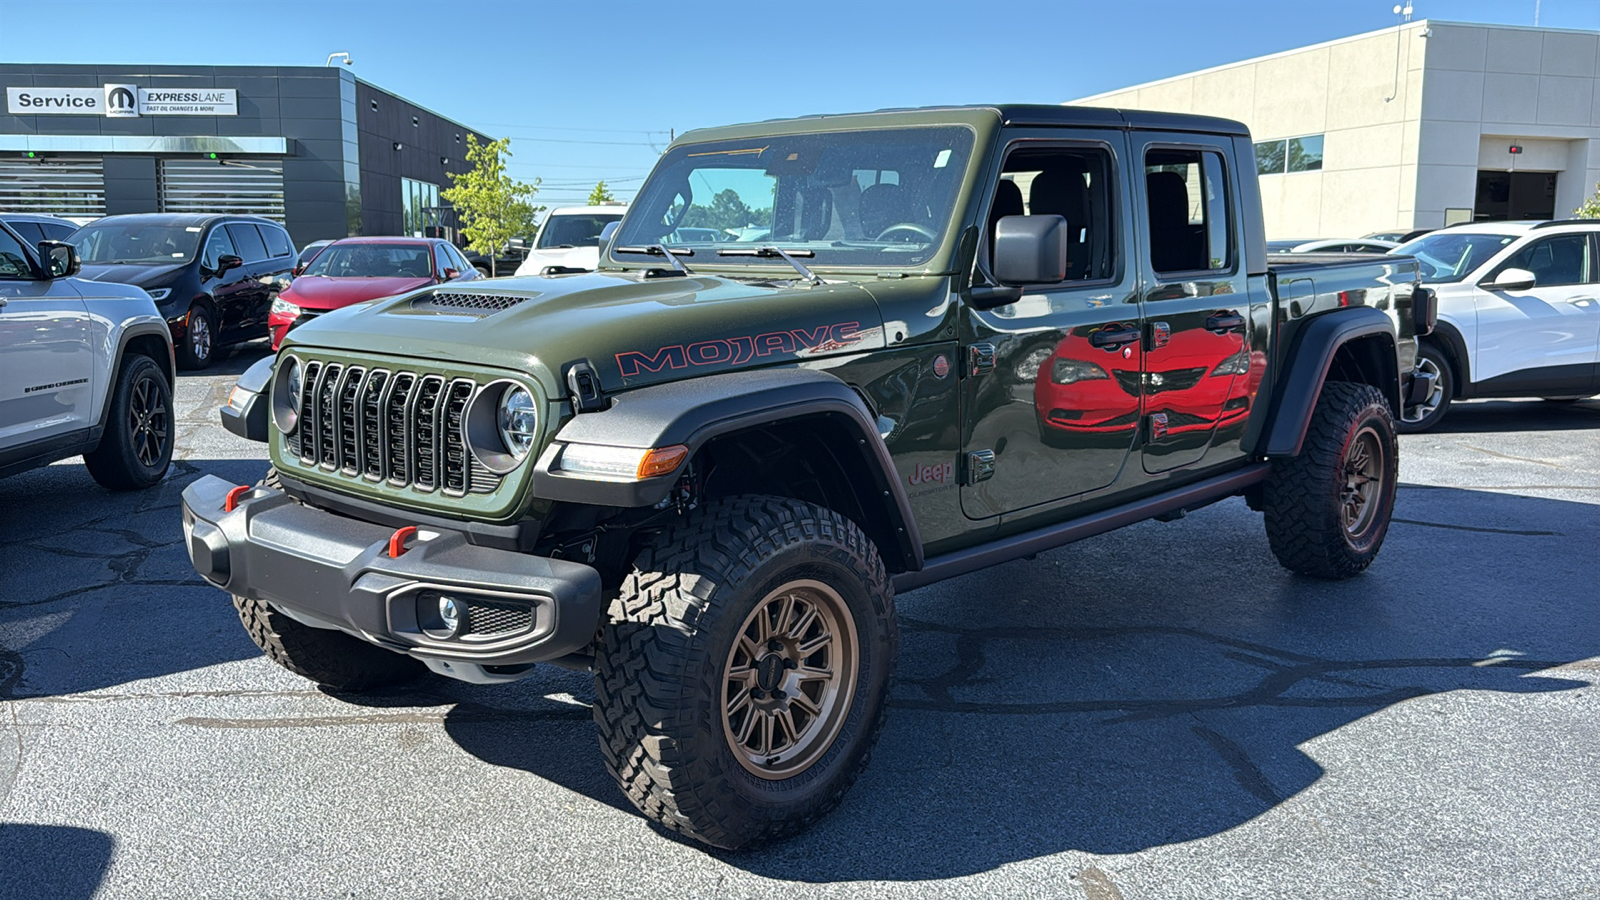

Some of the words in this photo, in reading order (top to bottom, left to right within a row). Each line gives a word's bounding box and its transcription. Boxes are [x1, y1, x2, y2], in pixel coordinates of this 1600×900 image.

[18, 93, 96, 108] Service
[614, 321, 862, 377] MOJAVE
[908, 461, 954, 487] Jeep
